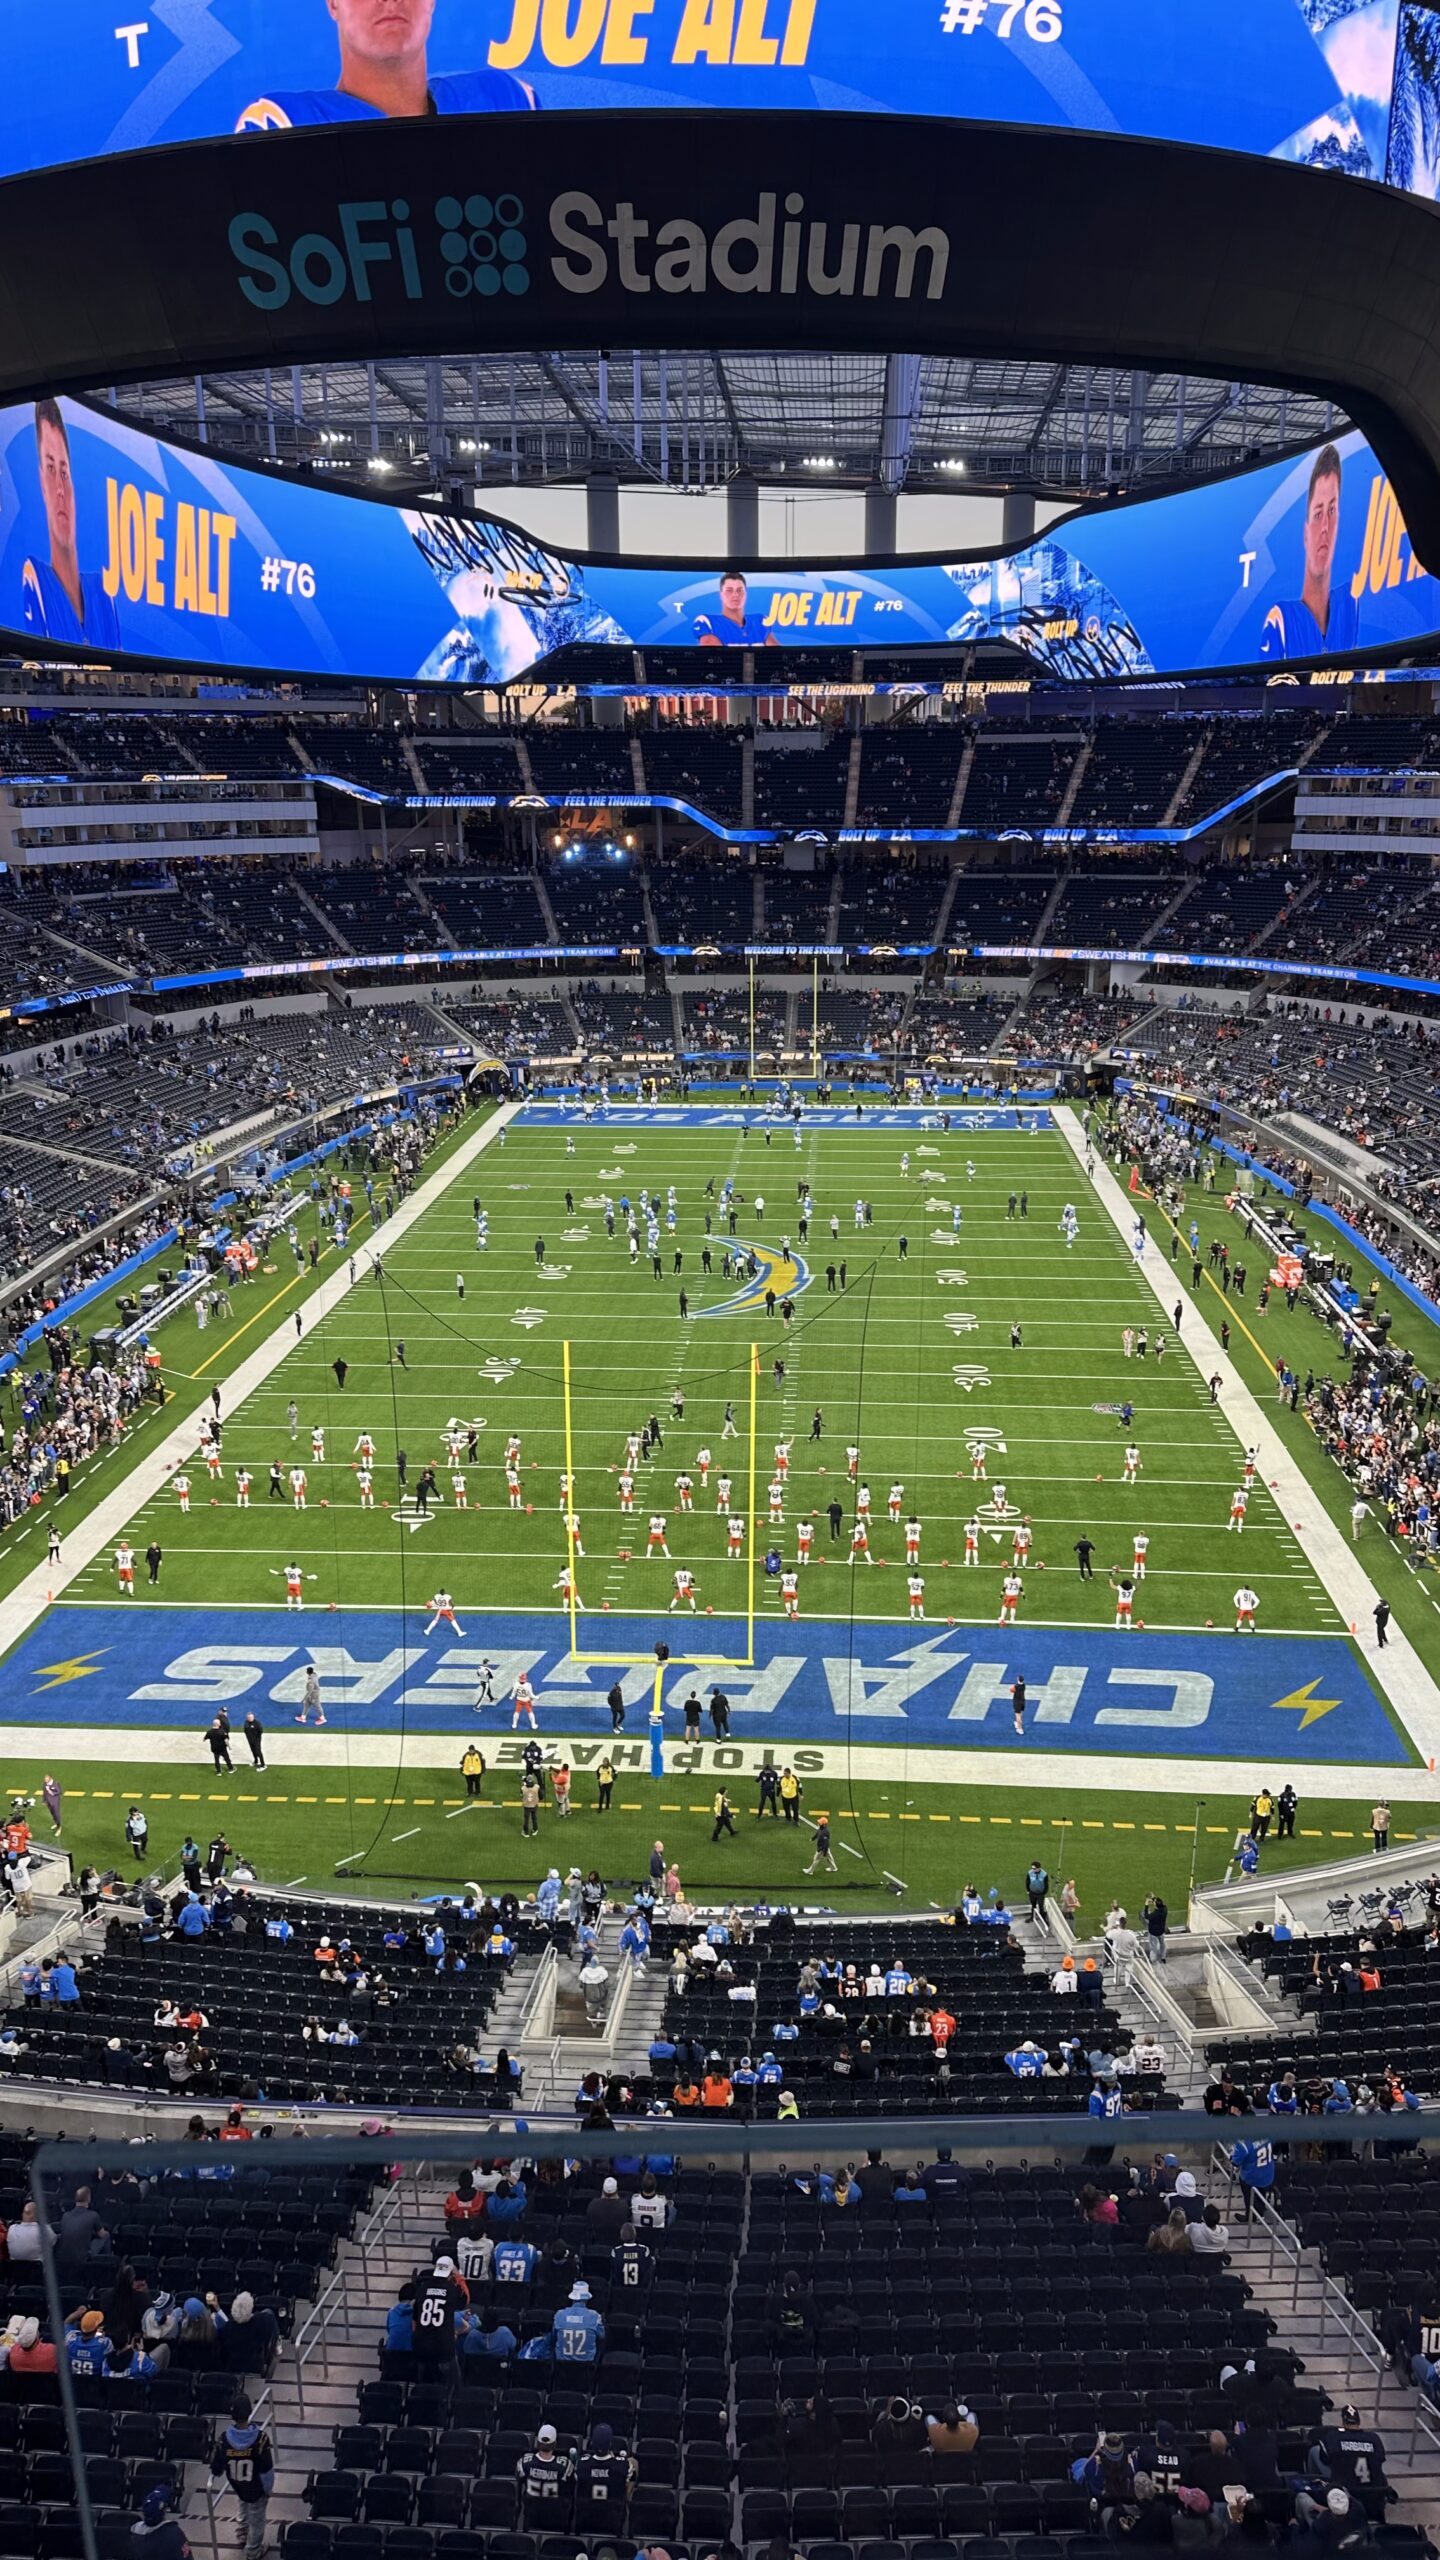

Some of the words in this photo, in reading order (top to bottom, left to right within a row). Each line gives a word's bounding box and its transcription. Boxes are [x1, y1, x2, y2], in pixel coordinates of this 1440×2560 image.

[939, 0, 1063, 43] #76
[488, 0, 655, 70] JOE
[115, 22, 149, 68] T
[228, 198, 423, 310] SoFi
[549, 191, 950, 300] Stadium
[103, 477, 165, 606] JOE
[174, 502, 237, 617] ALT
[1238, 552, 1256, 588] T
[261, 556, 316, 599] #76
[673, 603, 683, 613] T
[763, 591, 813, 627] JOE
[818, 591, 861, 627] ALT
[873, 598, 904, 612] #76
[1310, 672, 1337, 685] BOLT
[1338, 671, 1354, 684] UP
[1363, 670, 1386, 683] LA
[506, 685, 530, 696] BOLT
[532, 685, 547, 696] UP
[557, 685, 577, 696] LA
[788, 685, 805, 696] SEE
[807, 685, 823, 696] THE
[824, 684, 876, 695] LIGHTNING
[943, 682, 964, 693] FEEL
[966, 682, 985, 692] THE
[985, 681, 1031, 692] THUNDER
[405, 796, 423, 807] SEE
[424, 796, 443, 807] THE
[443, 796, 497, 807] LIGHTNING
[564, 796, 586, 806] FEEL
[588, 796, 606, 806] THE
[607, 796, 652, 806] THUNDER
[571, 808, 613, 833] LA
[838, 830, 865, 842] BOLT
[865, 830, 881, 841] UP
[1043, 829, 1070, 841] BOLT
[1070, 829, 1087, 841] UP
[452, 950, 495, 960] AVAILABLE
[524, 949, 564, 957] CHARGERS
[744, 946, 784, 955] WELCOME
[786, 946, 797, 954] TO
[798, 946, 813, 954] THE
[814, 946, 844, 954] STORM
[1078, 950, 1148, 961] SWEATSHIRT
[331, 956, 397, 969] SWEATSHIRT
[1204, 958, 1246, 967] AVAILABLE
[1259, 961, 1271, 969] THE
[1273, 962, 1311, 973] CHARGERS
[567, 1113, 690, 1122] LOS
[698, 1113, 997, 1126] ANGELES
[478, 1356, 522, 1379] 30
[952, 1364, 992, 1387] 30
[438, 1598, 447, 1607] 99
[127, 1628, 1217, 1729] CHARGERS
[495, 1742, 643, 1767] HATE
[673, 1747, 824, 1773] STOP
[210, 1849, 216, 1863] 1
[968, 1902, 979, 1916] 10
[873, 1984, 879, 1995] 1
[889, 1978, 906, 1994] 20
[1067, 1980, 1072, 1991] 1
[1332, 1982, 1338, 1994] 1
[936, 2023, 948, 2035] 23
[1142, 2057, 1161, 2071] 23
[1105, 2094, 1122, 2118] 97
[1256, 2144, 1272, 2168] 21
[463, 2209, 469, 2219] 1
[464, 2254, 484, 2279] 10
[499, 2259, 526, 2282] 33
[622, 2262, 639, 2286] 13
[420, 2299, 447, 2327] 85
[563, 2329, 587, 2356] 32
[1420, 2326, 1440, 2355] 10
[1340, 2440, 1374, 2453] HARBAUGH
[1157, 2454, 1179, 2466] SEAU
[226, 2459, 253, 2482] 10
[590, 2468, 610, 2478] NOVAK
[1354, 2456, 1371, 2483] 4
[526, 2479, 559, 2498] 56
[1150, 2471, 1182, 2494] 55
